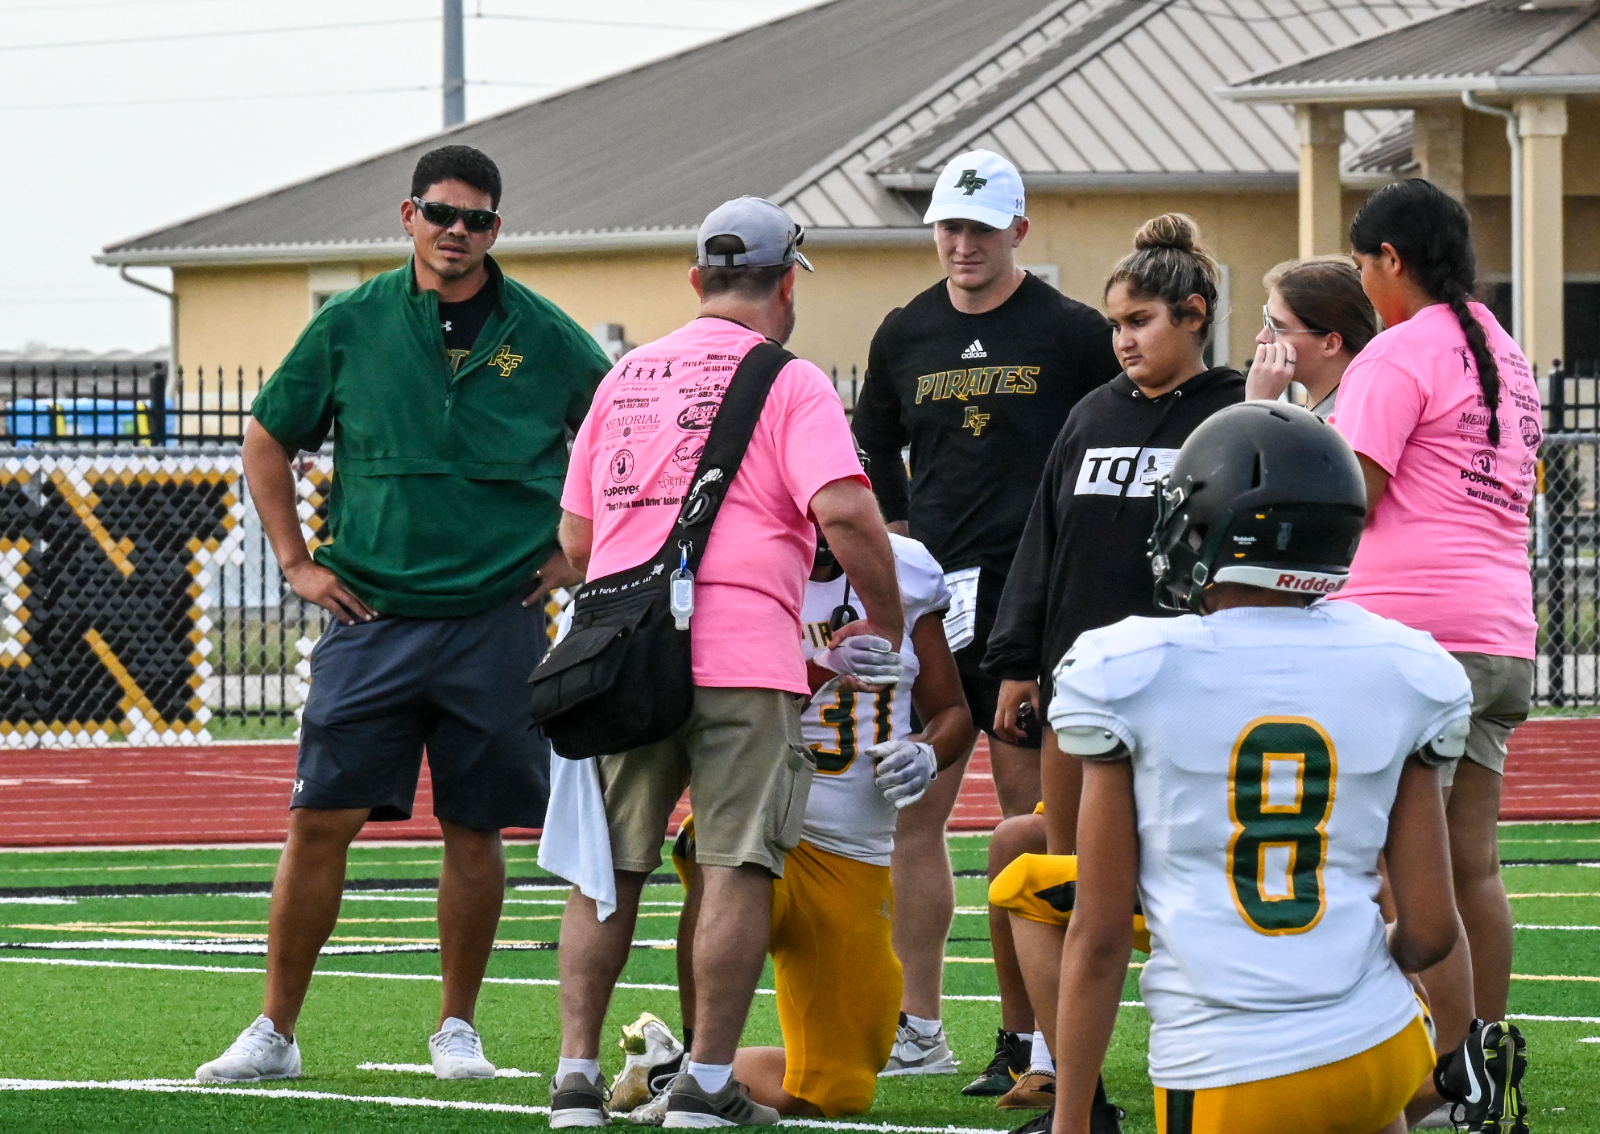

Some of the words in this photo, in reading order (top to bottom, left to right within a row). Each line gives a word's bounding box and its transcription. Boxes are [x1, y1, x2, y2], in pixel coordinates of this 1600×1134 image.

[961, 351, 987, 360] adidas
[915, 366, 1041, 405] PIRATES
[632, 499, 644, 508] and
[808, 684, 894, 776] 31
[1226, 715, 1338, 936] 8
